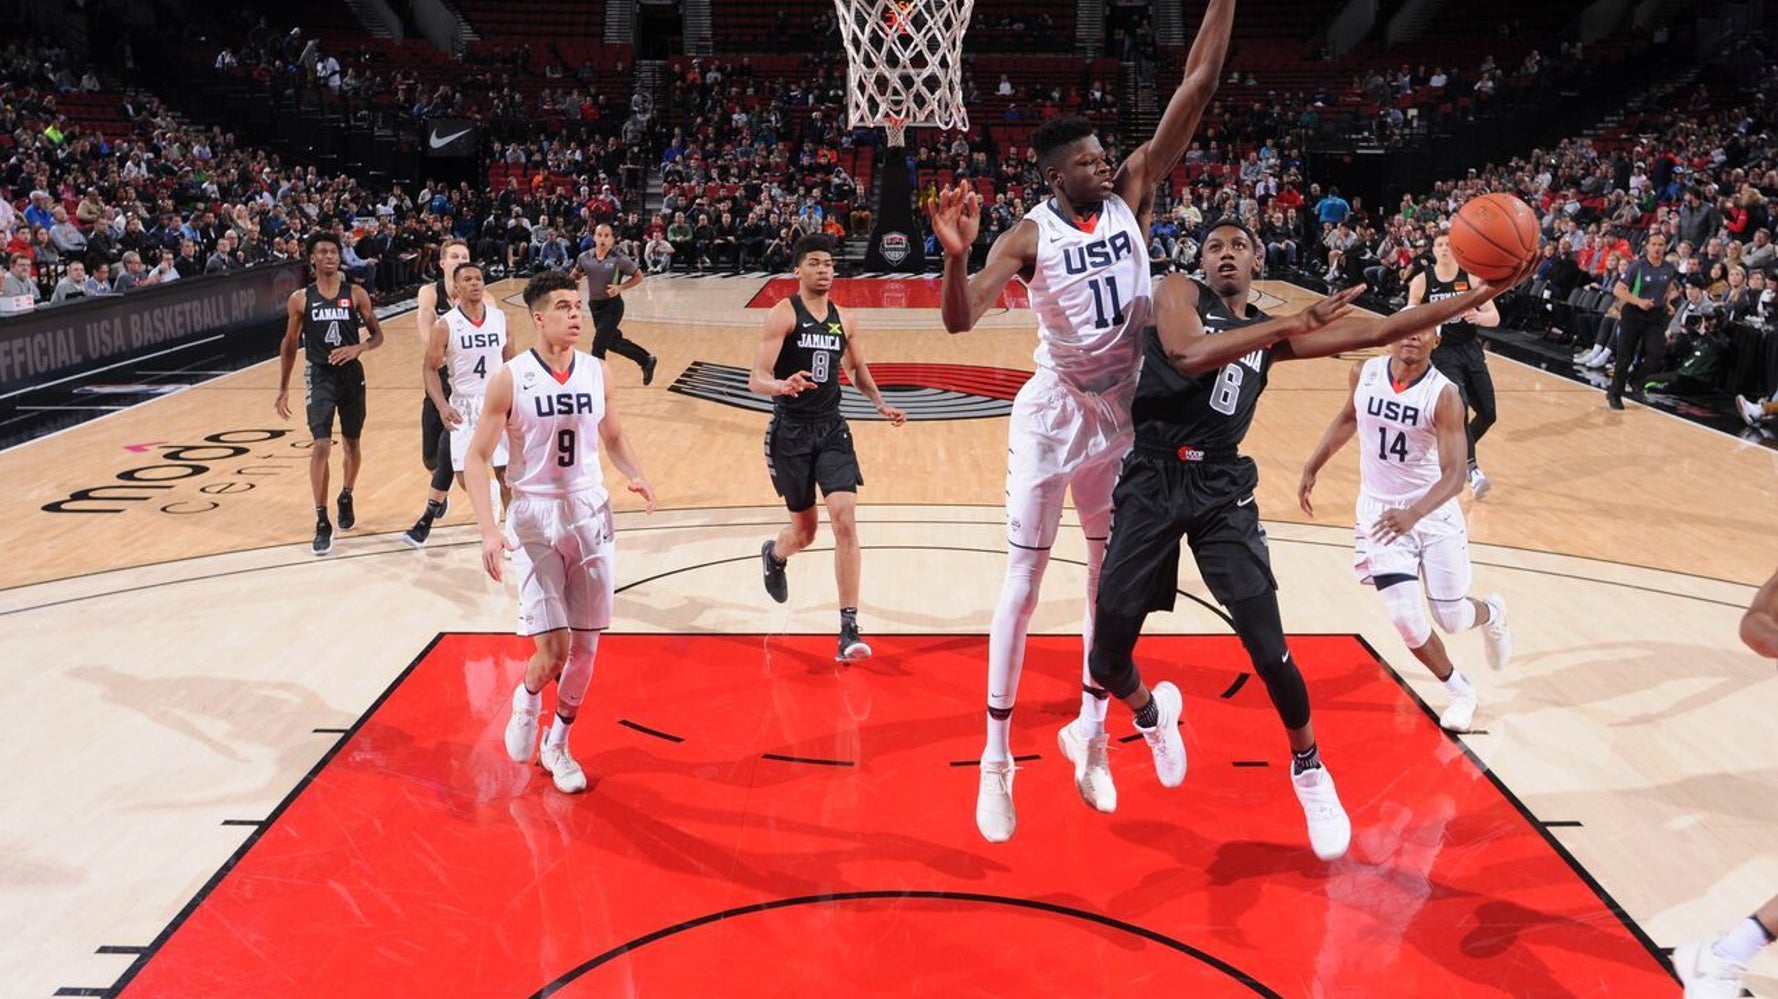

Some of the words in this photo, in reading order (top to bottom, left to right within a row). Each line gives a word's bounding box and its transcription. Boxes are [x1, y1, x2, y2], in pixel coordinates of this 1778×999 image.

[1063, 231, 1132, 275] USA
[312, 308, 350, 321] CANADA
[1088, 275, 1124, 329] 11
[86, 317, 127, 359] USA
[130, 294, 228, 348] BASKETBALL
[231, 288, 256, 322] APP
[325, 321, 342, 346] 4
[461, 333, 499, 349] USA
[797, 333, 840, 351] JAMAICA
[473, 355, 486, 379] 4
[812, 350, 829, 383] 8
[535, 393, 592, 417] USA
[1209, 363, 1244, 415] 6
[1367, 396, 1419, 426] USA
[558, 429, 575, 467] 9
[1379, 427, 1408, 462] 14
[41, 429, 295, 513] moda
